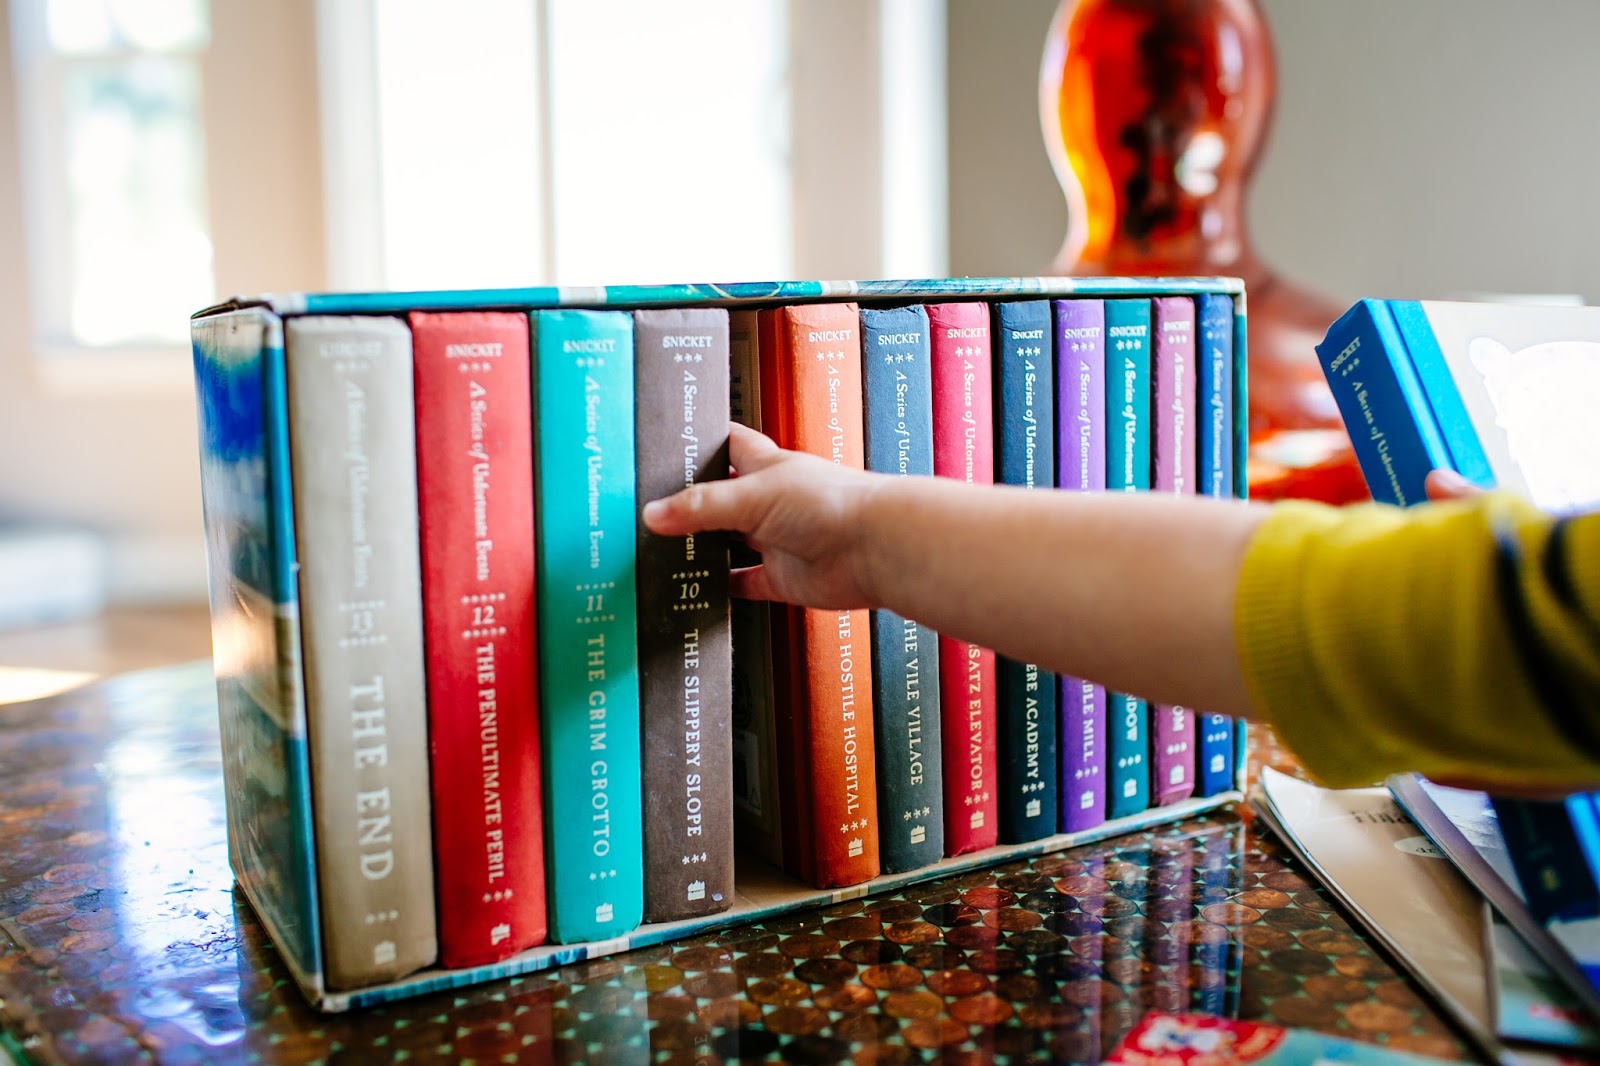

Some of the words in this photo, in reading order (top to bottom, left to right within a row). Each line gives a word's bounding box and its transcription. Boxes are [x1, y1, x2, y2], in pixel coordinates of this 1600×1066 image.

[563, 339, 615, 354] SNICKET
[662, 335, 713, 349] SNICKET
[808, 330, 852, 343] SNICKET
[878, 333, 921, 346] SNICKET
[947, 327, 987, 339] SNICKET
[1011, 329, 1044, 340] SNICKET
[1064, 327, 1101, 339] SNICKET
[1109, 325, 1147, 338] SNICKET
[445, 342, 503, 358] SNICKET
[964, 360, 975, 372] A
[1025, 359, 1036, 371] A
[1080, 360, 1090, 372] A
[1124, 358, 1136, 369] A
[1174, 352, 1184, 363] A
[1213, 347, 1223, 359] A
[1331, 337, 1361, 371] SNICKET
[584, 376, 600, 393] A
[684, 370, 697, 383] A
[828, 364, 840, 376] A
[895, 370, 908, 382] A
[1124, 369, 1137, 403] Series
[469, 381, 487, 399] A
[684, 384, 698, 423] Series
[828, 377, 841, 414] Series
[896, 382, 909, 418] Series
[964, 373, 976, 408] Series
[1025, 371, 1037, 407] Series
[1080, 373, 1091, 407] Series
[470, 400, 488, 442] Series
[585, 393, 601, 433] Series
[827, 416, 843, 433] of
[962, 410, 976, 425] of
[1022, 409, 1036, 424] of
[1077, 409, 1091, 424] of
[1121, 404, 1137, 420] of
[1352, 381, 1363, 391] A
[1358, 391, 1373, 423] Series
[1370, 426, 1385, 441] of
[583, 434, 602, 454] of
[681, 425, 698, 442] of
[894, 421, 910, 437] of
[468, 441, 489, 460] of
[1080, 425, 1091, 489] Unfortunate
[472, 463, 490, 536] Unfortunate
[588, 456, 602, 528] Unfortunate
[476, 539, 493, 581] Events
[589, 530, 604, 570] Events
[585, 595, 604, 613] 11
[680, 582, 700, 600] 10
[471, 605, 496, 625] 12
[838, 610, 851, 639] HE
[476, 642, 496, 683] THE
[587, 634, 605, 682] THE
[684, 629, 699, 669] THE
[840, 643, 856, 721] HOSTILE
[906, 658, 920, 701] VILE
[352, 675, 387, 768] THE
[588, 690, 607, 752] GRIM
[684, 675, 701, 768] SLIPPERY
[908, 705, 924, 786] VILLAGE
[969, 698, 983, 791] ELEVATOR
[1026, 698, 1039, 779] ACADEMY
[1083, 719, 1094, 762] MILL
[479, 689, 502, 825] PENULTIMATE
[844, 726, 860, 815] HOSPITAL
[591, 760, 610, 858] GROTTO
[686, 773, 702, 837] SLOPE
[356, 788, 394, 880] END
[486, 828, 505, 883] PERIL
